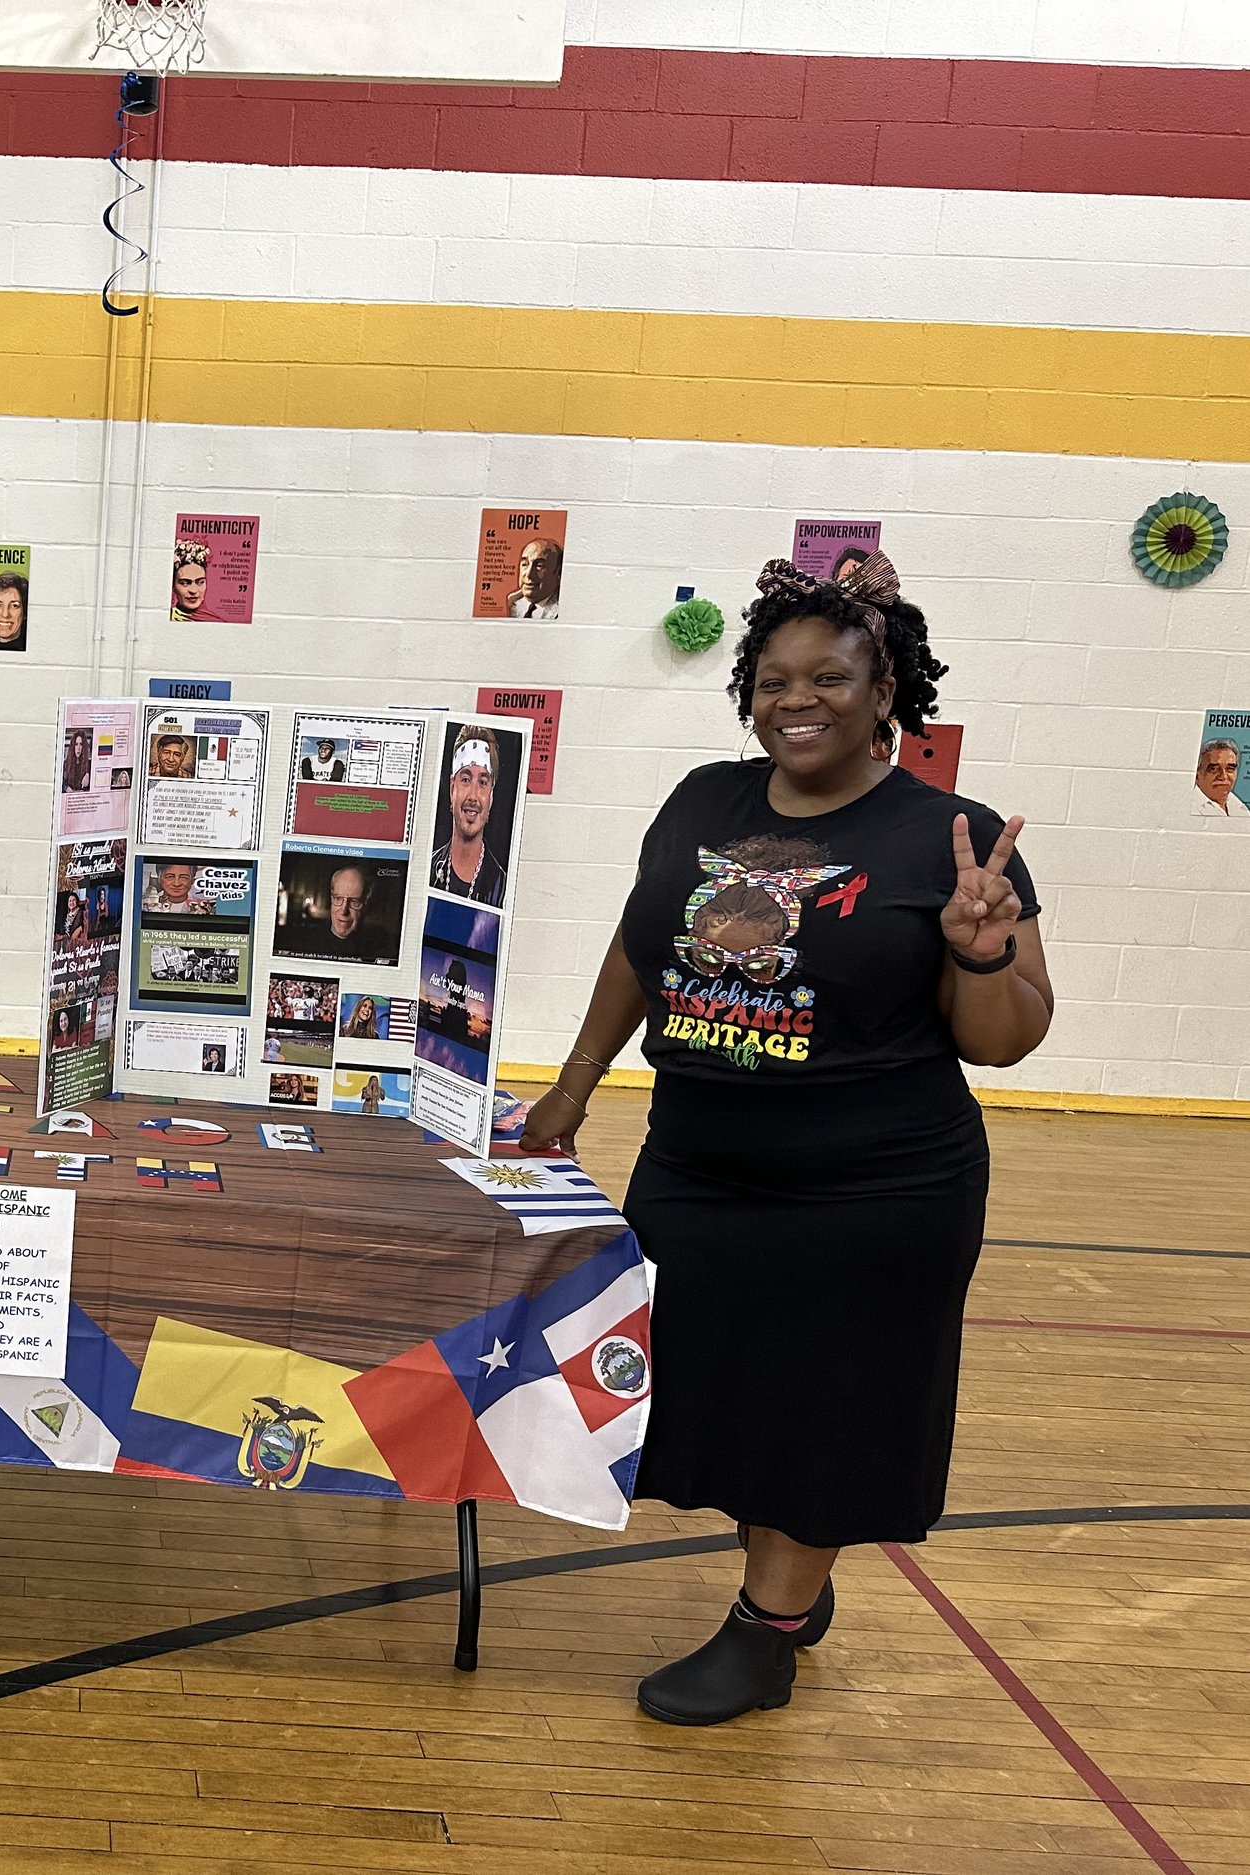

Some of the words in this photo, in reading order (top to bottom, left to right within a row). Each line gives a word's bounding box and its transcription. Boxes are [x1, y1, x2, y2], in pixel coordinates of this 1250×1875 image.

[180, 520, 255, 535] AUTHENTICITY
[508, 514, 540, 530] HOPE
[799, 524, 877, 538] EMPOWERMENT
[168, 684, 212, 699] LEGACY
[494, 693, 546, 709] GROWTH
[286, 844, 311, 852] Roberto
[312, 846, 345, 854] Clemente
[345, 848, 364, 856] video
[205, 869, 244, 878] Cesar
[196, 880, 247, 890] Chavez
[209, 934, 248, 943] successful
[684, 978, 785, 1012] Celebrate
[660, 990, 814, 1034] HISPANIC
[663, 1014, 810, 1062] HERITAGE
[7, 1248, 47, 1258] ABOUT
[1, 1277, 60, 1289] HISPANIC
[17, 1292, 57, 1305] FACTS,
[18, 1337, 40, 1346] ARE
[45, 1339, 52, 1347] A
